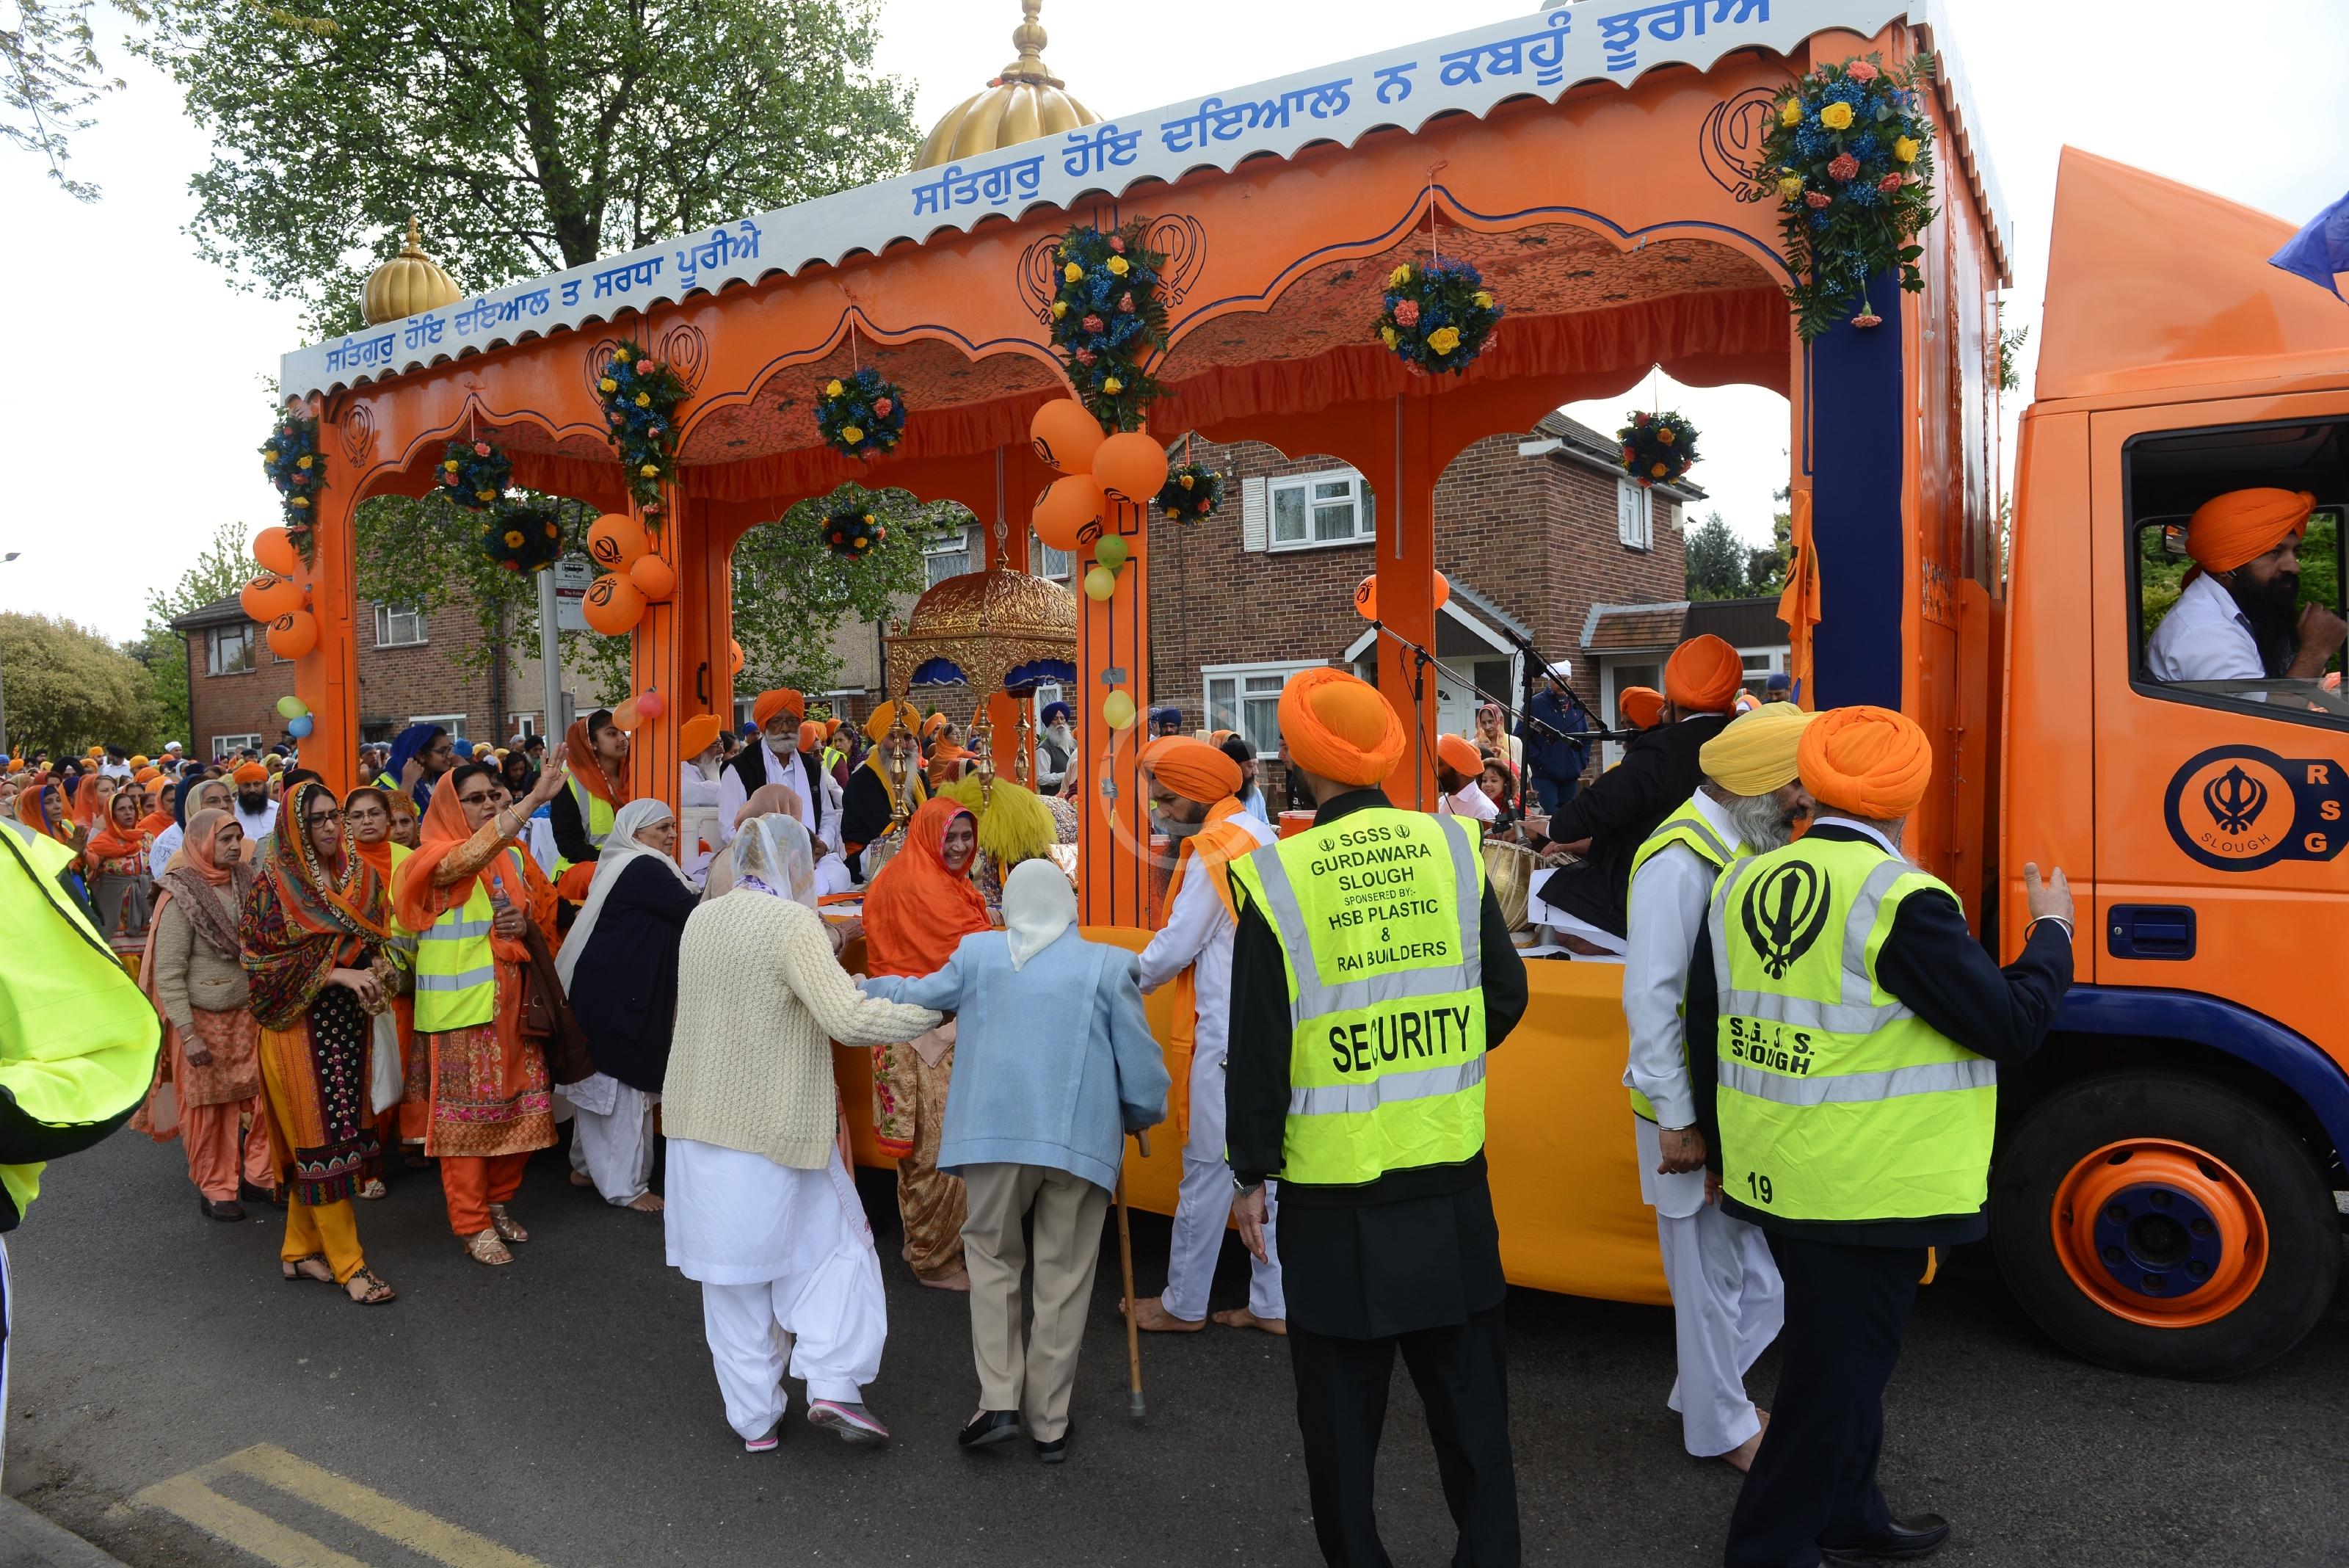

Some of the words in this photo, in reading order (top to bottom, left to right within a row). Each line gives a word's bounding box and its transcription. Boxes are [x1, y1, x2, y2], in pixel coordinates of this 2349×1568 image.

[1062, 124, 1142, 177] ਹੋਇ
[1161, 78, 1352, 153] ਦਇਆਲ
[1374, 62, 1417, 104] ਨ
[404, 313, 445, 349] ਹੋਇ
[454, 288, 550, 335] ਦਇਆਲ
[561, 279, 581, 306] ਤ
[593, 256, 664, 299] ਸਰਧਾ
[676, 220, 761, 289] ਪੂਰੀਐ
[1340, 827, 1391, 847] SGSS
[2201, 832, 2270, 853] SLOUGH
[1311, 843, 1432, 876] GURDAWARA
[1339, 866, 1414, 891] SLOUGH
[1344, 890, 1396, 906] SPONSERED
[1329, 910, 1363, 930] HSB
[1368, 899, 1438, 922] PLASTIC
[1381, 926, 1390, 942] &
[1337, 954, 1363, 972] RAI
[1368, 941, 1447, 966] BUILDERS
[1329, 1005, 1470, 1072] SECURITY
[1747, 1172, 1773, 1204] 19
